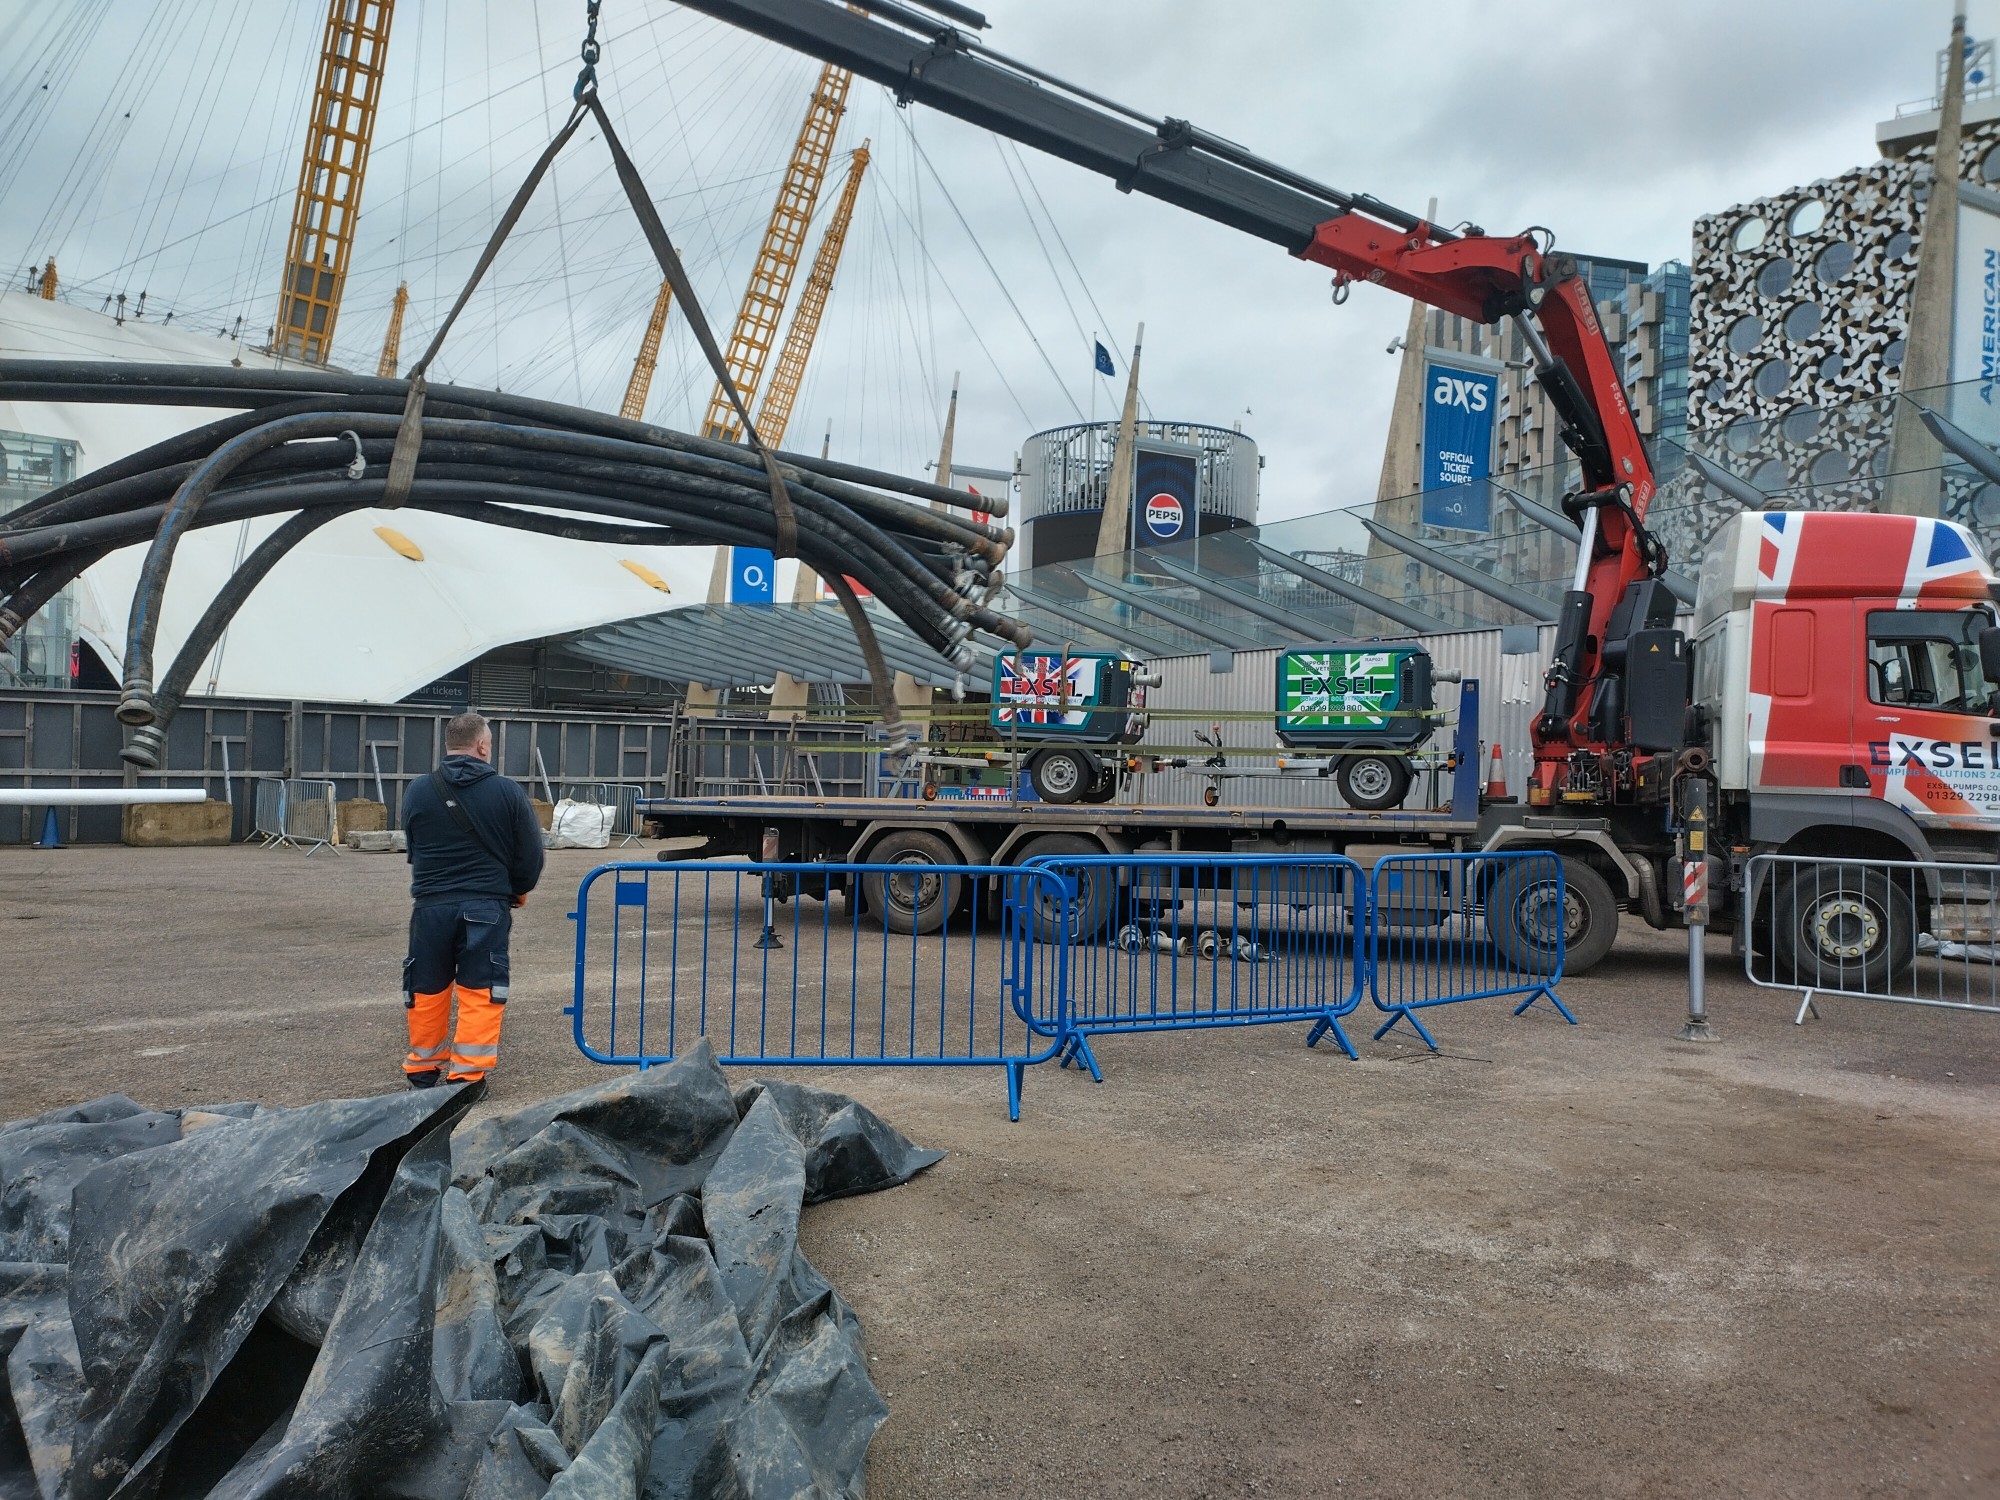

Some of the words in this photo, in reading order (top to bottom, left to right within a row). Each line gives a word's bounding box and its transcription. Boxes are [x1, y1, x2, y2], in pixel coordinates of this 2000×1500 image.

[1576, 286, 1597, 330] FASSI
[1980, 248, 1996, 406] AMERICAN
[1434, 376, 1488, 414] axs
[1439, 451, 1474, 464] OFFICIAL
[1442, 462, 1470, 474] TICKET
[1439, 472, 1472, 484] SOURCE
[1148, 509, 1180, 521] PEPSI
[743, 565, 768, 592] O2
[432, 685, 463, 696] tickets
[1301, 676, 1382, 695] EXSEL
[1868, 741, 2000, 770] EXSEL
[1869, 766, 1921, 776] PUMPING
[1924, 769, 1987, 779] SOLUTIONS
[1927, 791, 1963, 801] 01329
[1968, 792, 2000, 802] 2298
